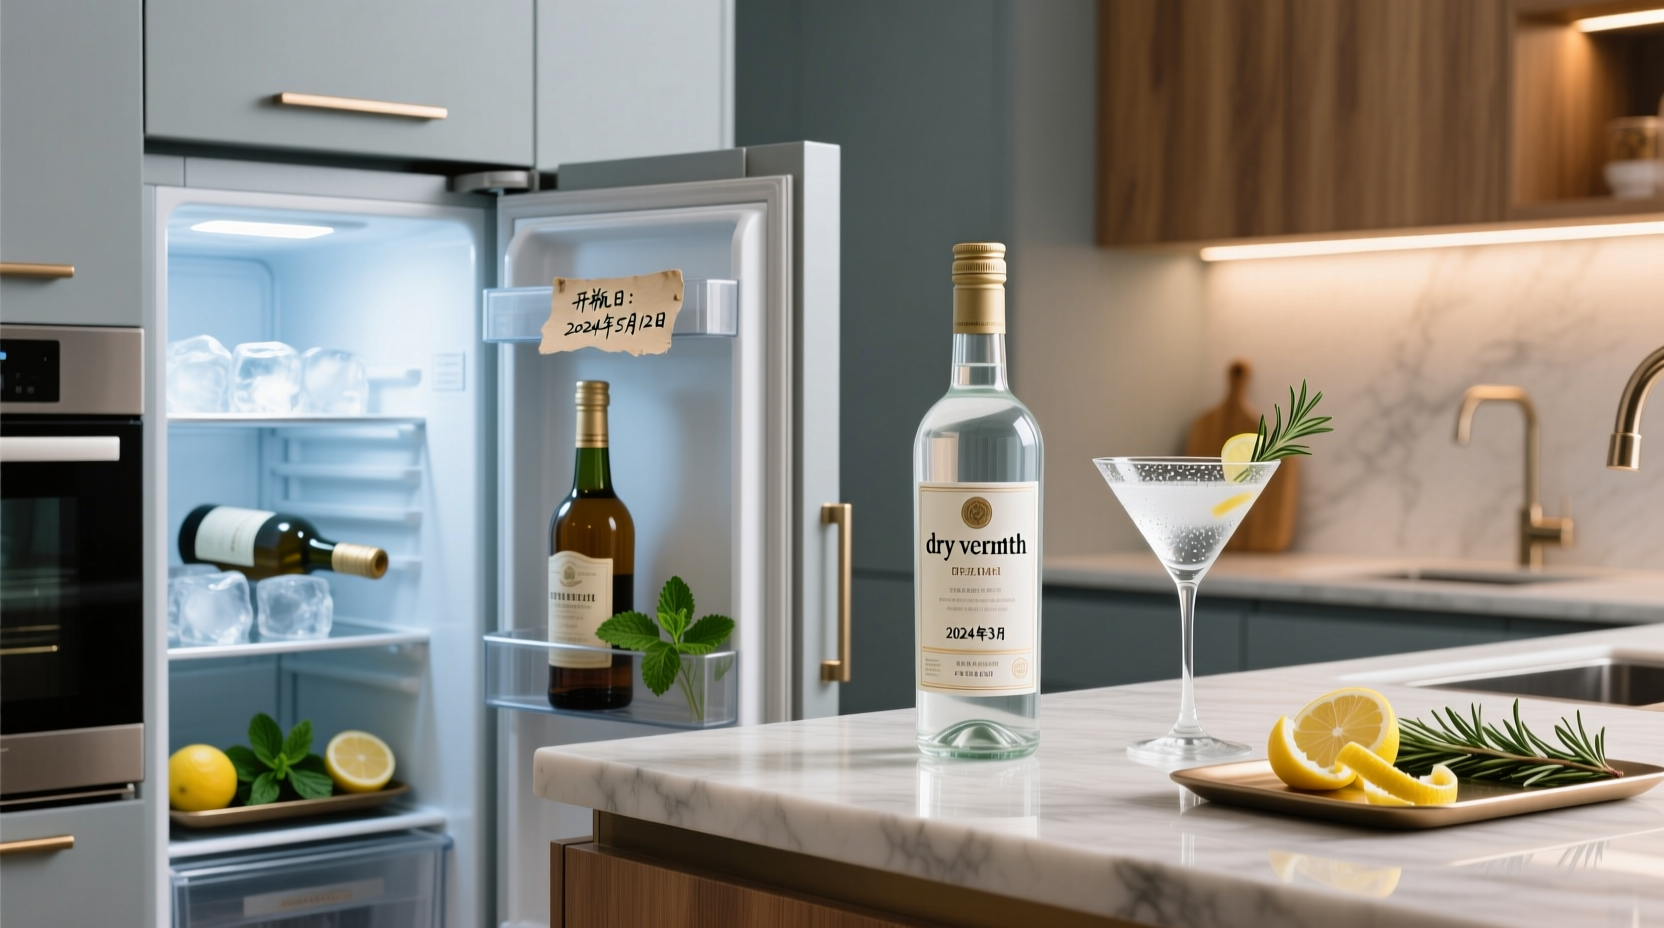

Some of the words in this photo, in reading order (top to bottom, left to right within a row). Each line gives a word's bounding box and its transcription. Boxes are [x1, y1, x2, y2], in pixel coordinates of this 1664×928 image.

[564, 312, 666, 340] 2024年5月12日
[926, 532, 955, 561] dry
[946, 625, 1005, 642] 2024年3月
